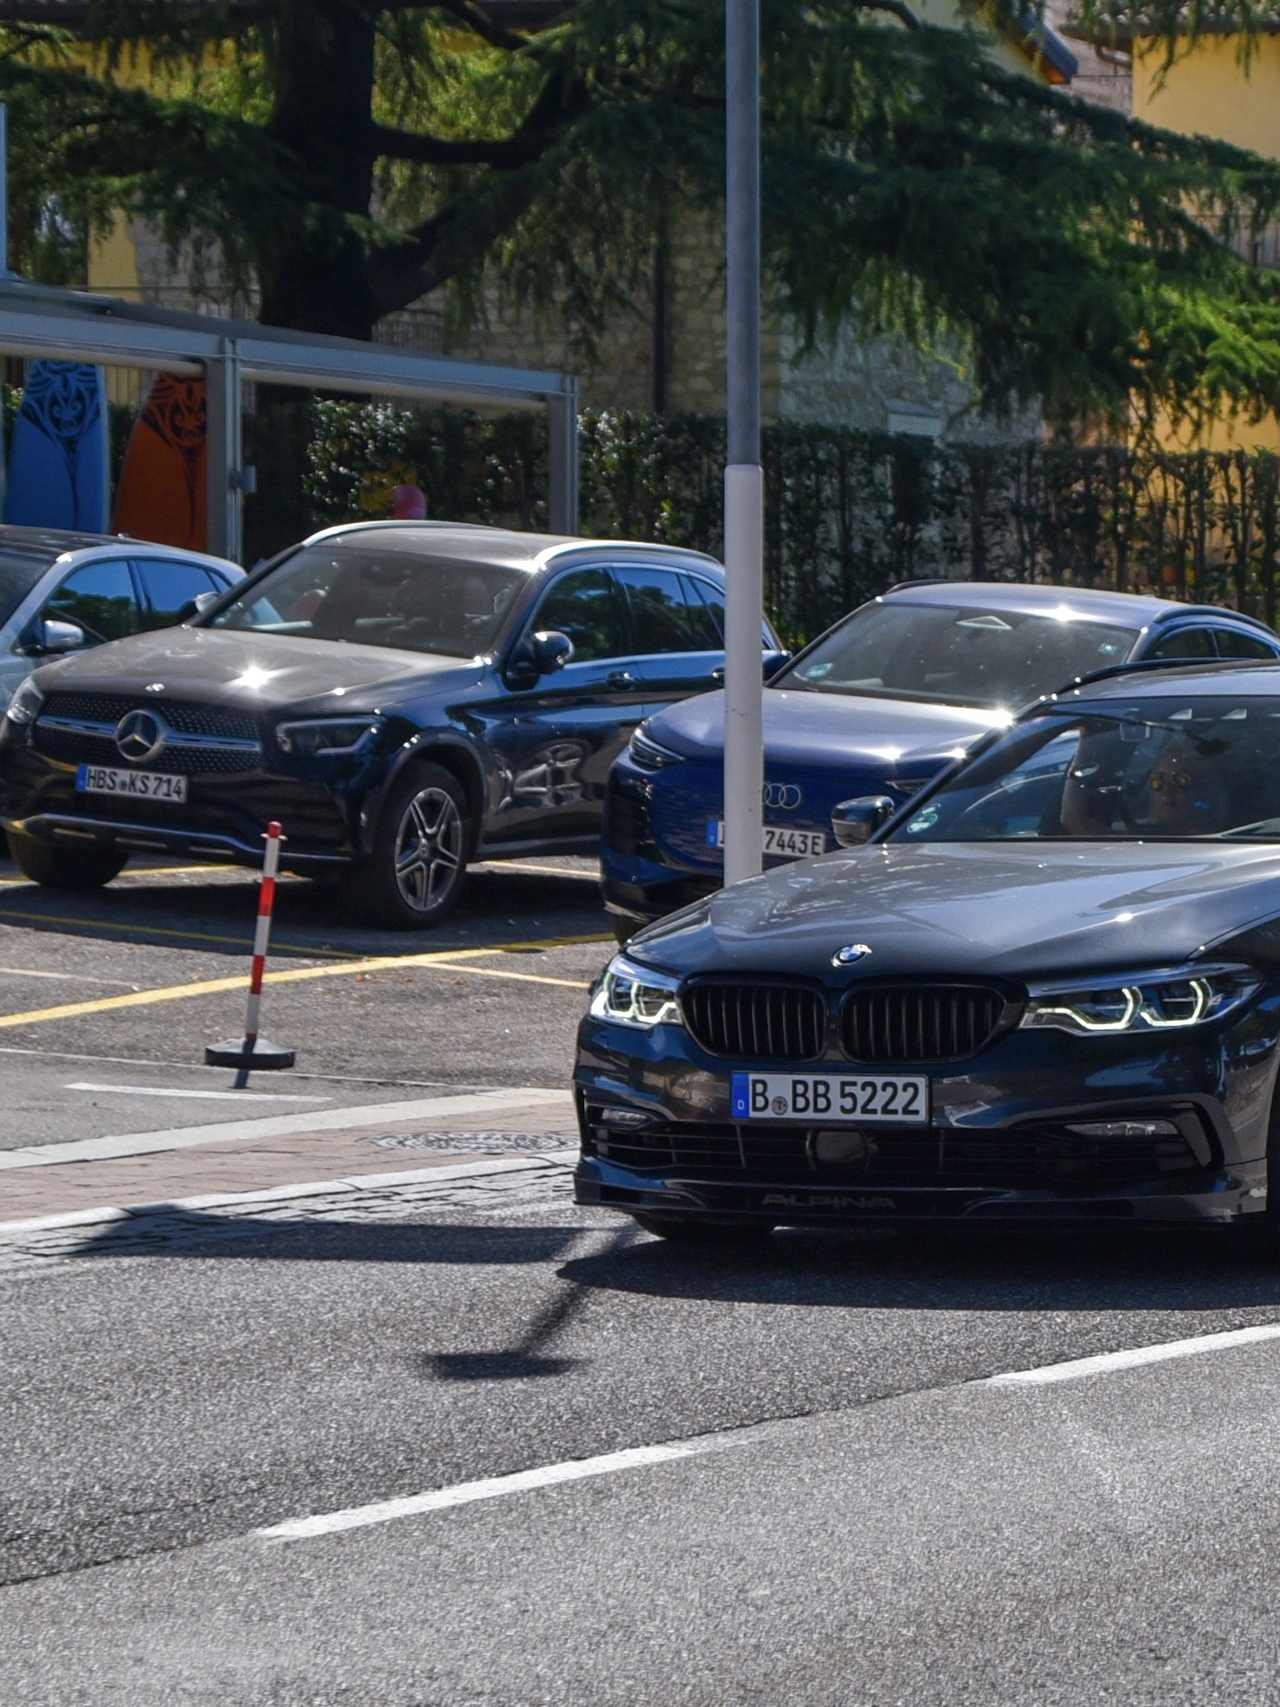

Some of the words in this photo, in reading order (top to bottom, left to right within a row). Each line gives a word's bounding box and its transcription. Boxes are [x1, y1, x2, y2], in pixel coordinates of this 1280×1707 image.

[86, 768, 118, 791] HBS
[128, 773, 150, 795] KS
[152, 776, 183, 799] 714
[765, 830, 821, 856] 7443E
[737, 1100, 745, 1110] D
[751, 1079, 770, 1112] B
[791, 1080, 832, 1113] BB
[839, 1081, 920, 1116] 5222
[761, 1194, 897, 1209] ALPINA
